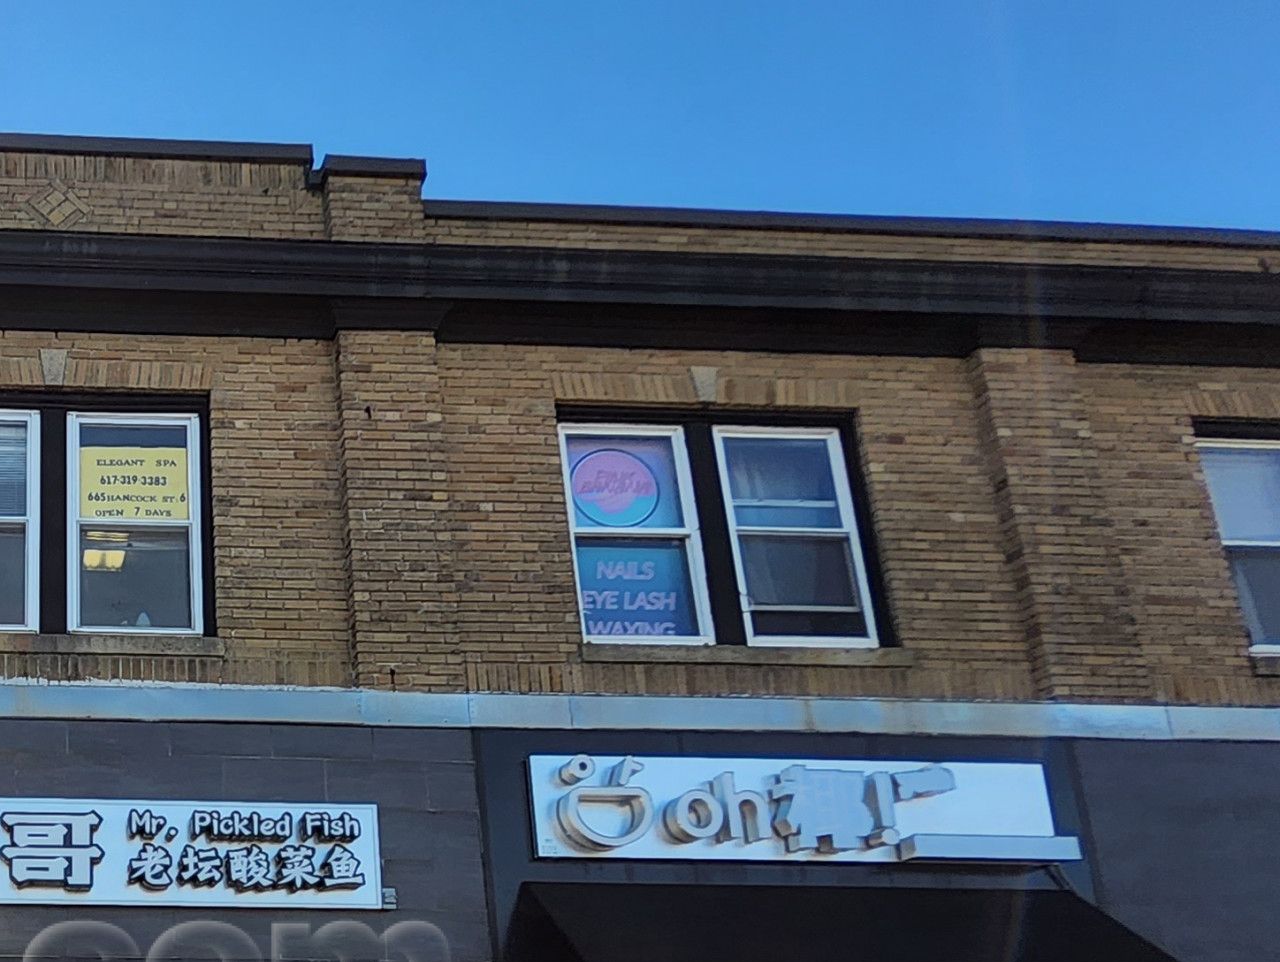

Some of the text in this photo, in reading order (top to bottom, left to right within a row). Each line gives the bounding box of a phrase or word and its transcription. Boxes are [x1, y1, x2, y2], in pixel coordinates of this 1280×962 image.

[155, 459, 177, 467] SPA
[95, 507, 172, 517] OPEN 7 DAYS
[596, 560, 656, 580] NAILS
[582, 590, 677, 611] EYE LASH
[128, 808, 362, 843] Mr. Pickled Fish
[128, 843, 366, 894] 老坛酸菜鱼
